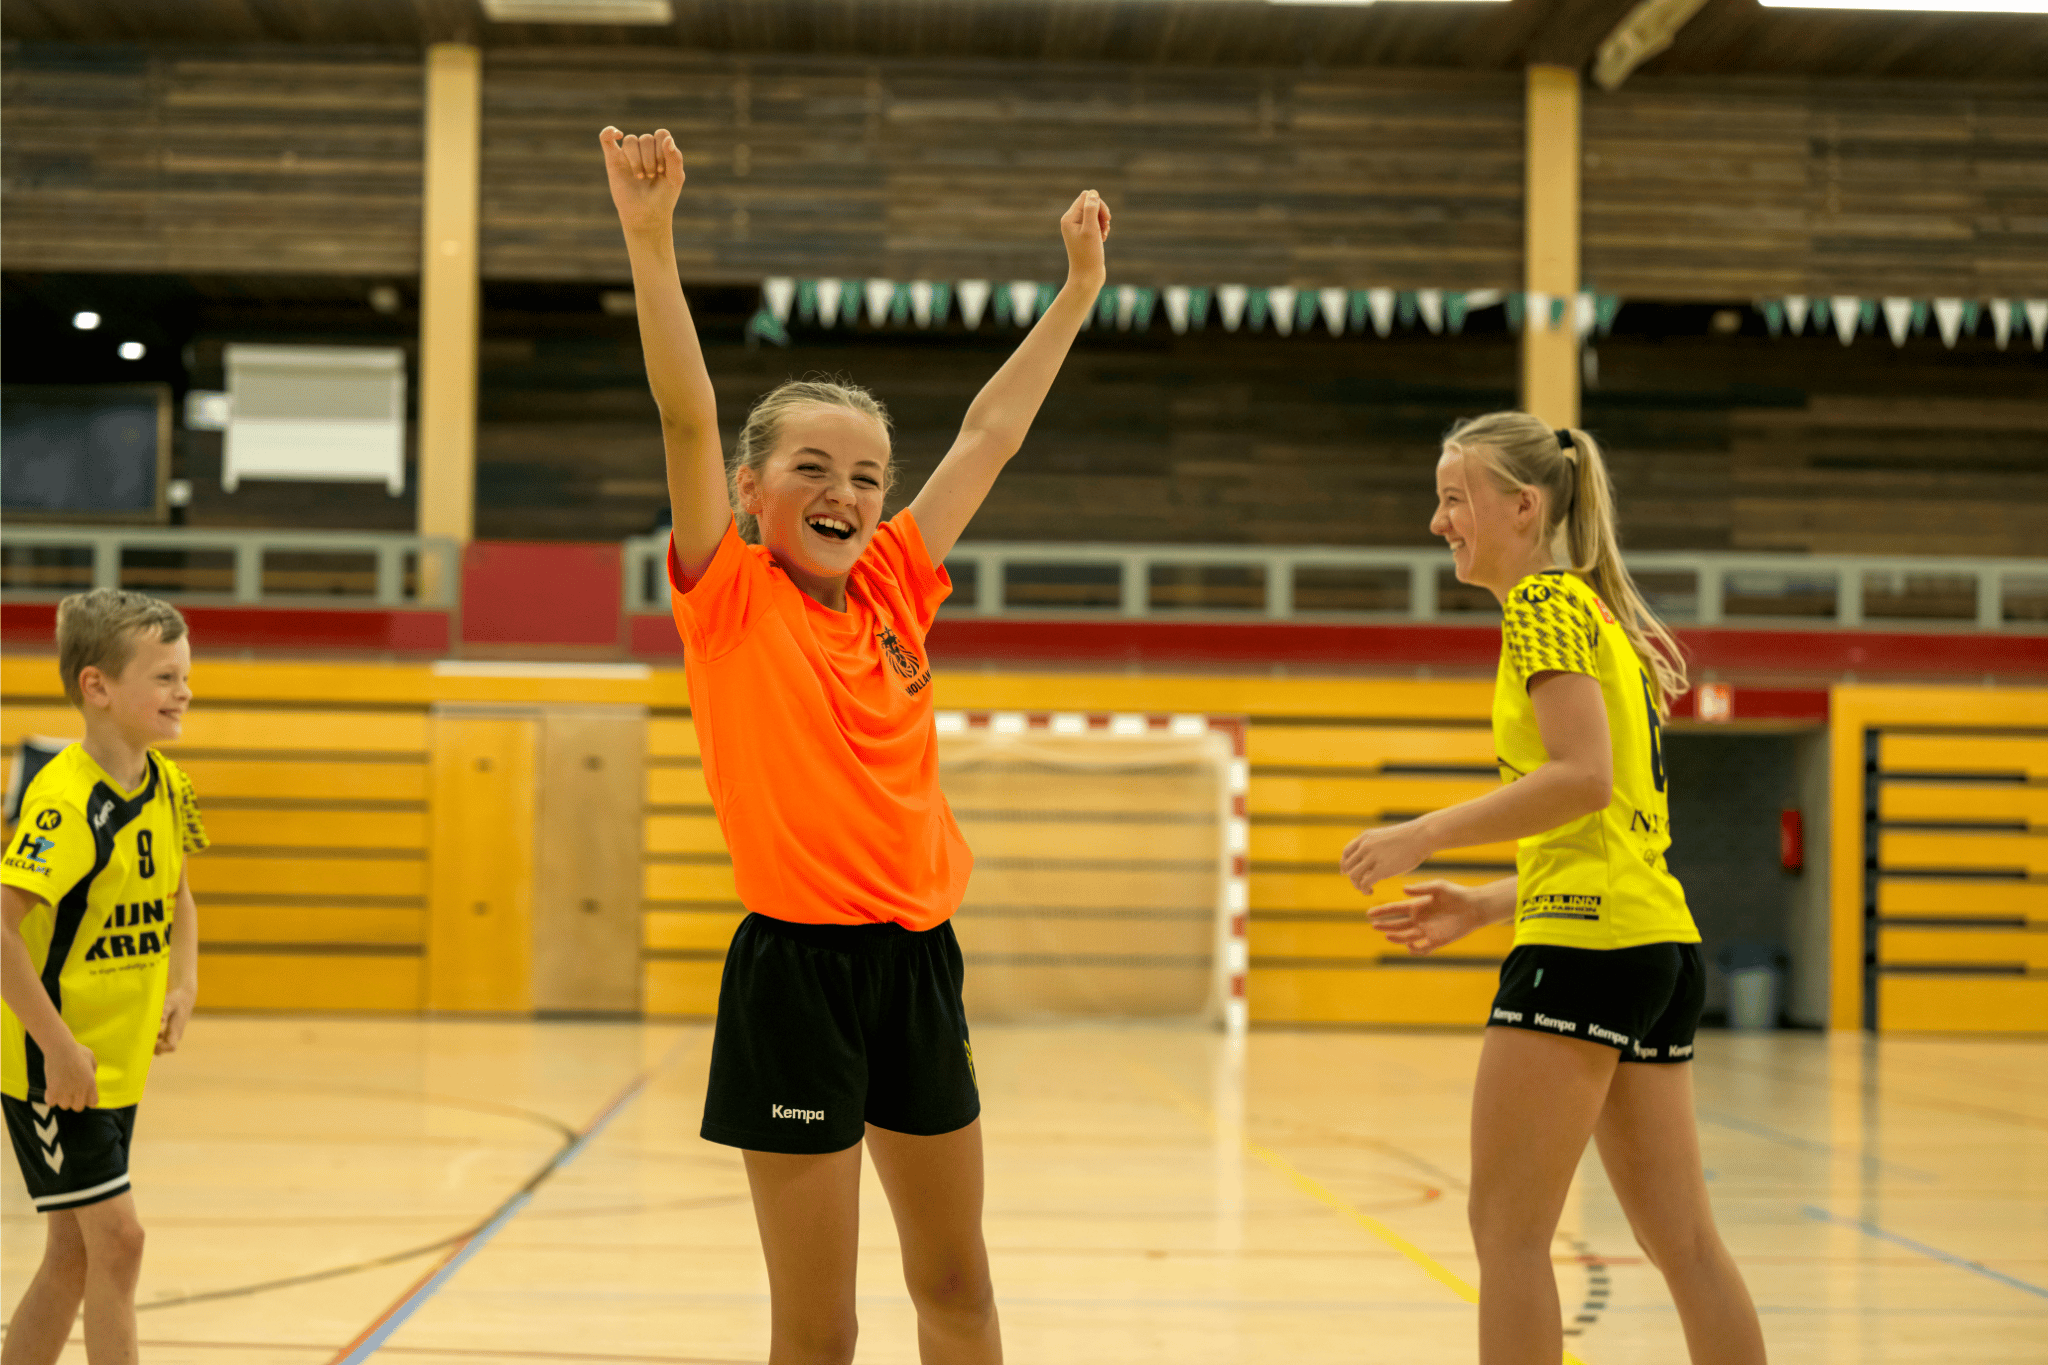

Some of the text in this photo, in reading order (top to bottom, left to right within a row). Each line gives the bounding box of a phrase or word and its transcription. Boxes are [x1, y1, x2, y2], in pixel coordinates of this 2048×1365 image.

[137, 829, 155, 879] 9
[1534, 1012, 1576, 1033] Kempa
[1588, 1023, 1629, 1046] Kempa
[772, 1103, 825, 1125] Kempa
